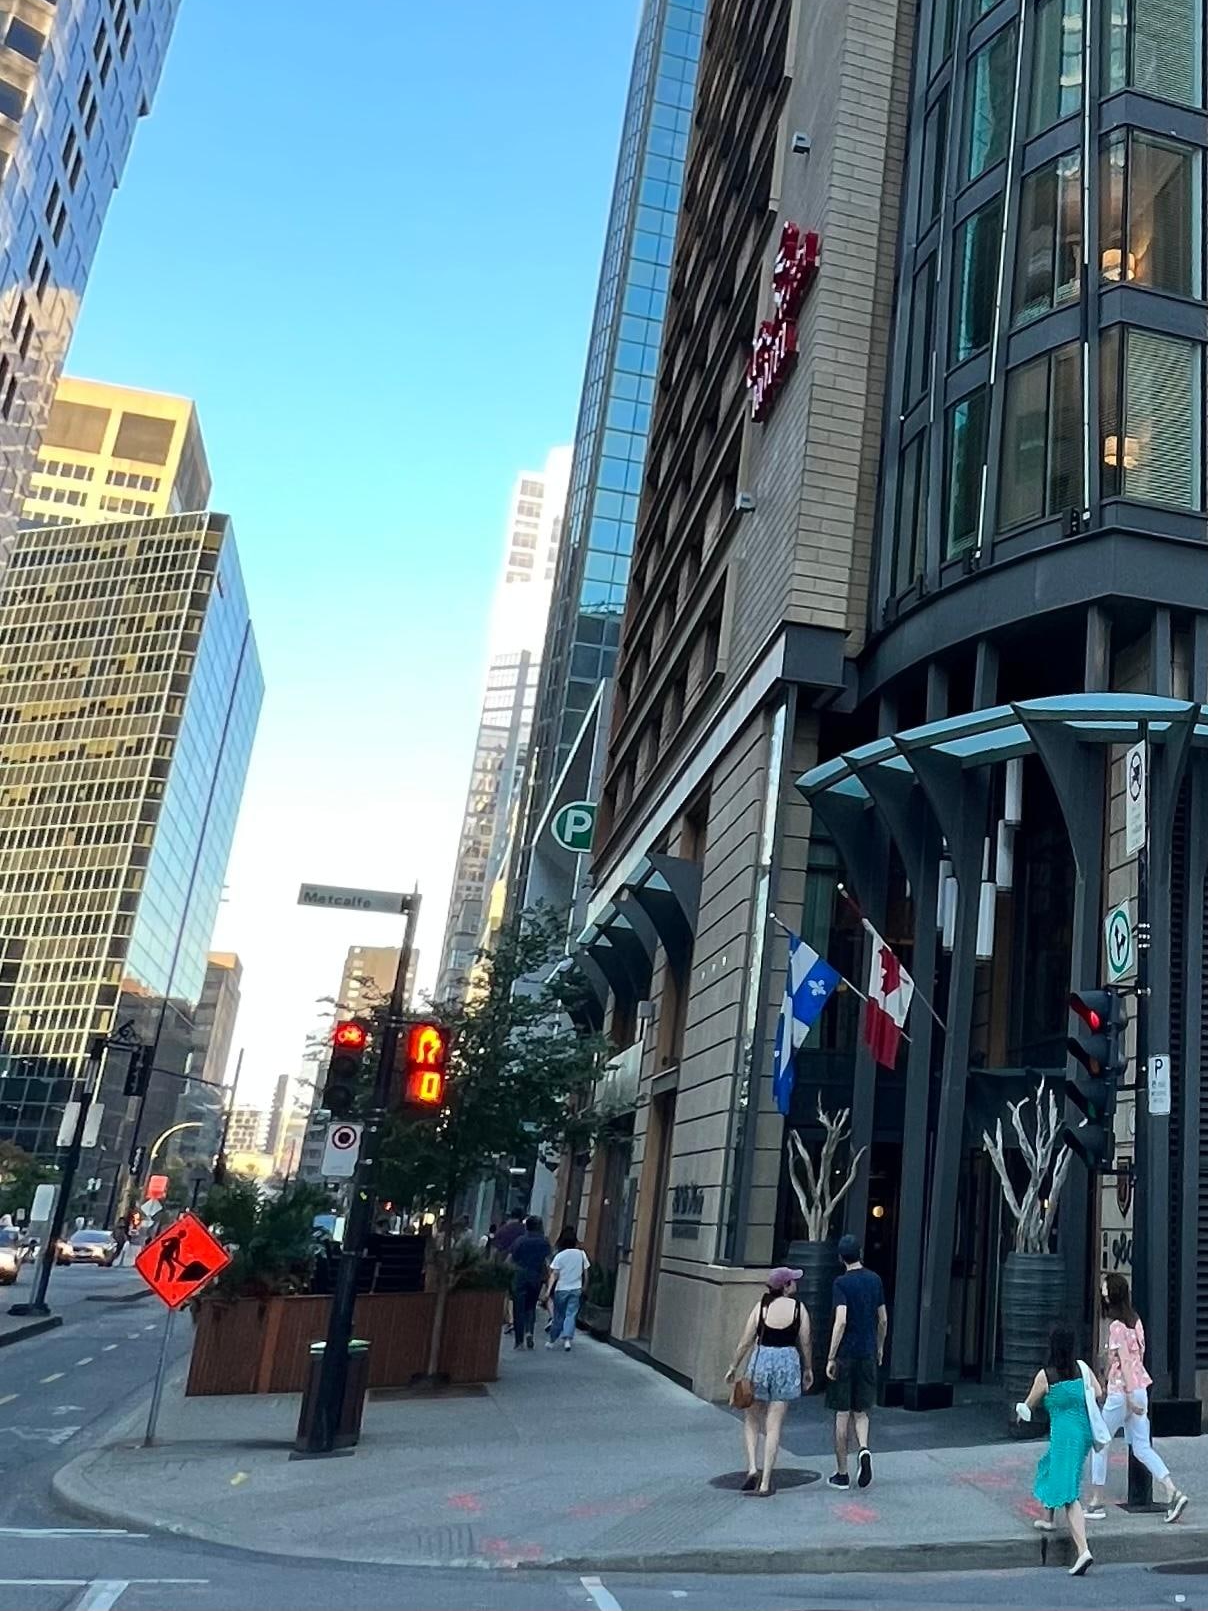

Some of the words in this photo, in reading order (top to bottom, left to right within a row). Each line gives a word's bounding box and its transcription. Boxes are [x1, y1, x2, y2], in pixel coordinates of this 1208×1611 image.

[564, 808, 593, 843] P
[303, 891, 372, 909] Metcalfe
[1154, 1058, 1164, 1079] P
